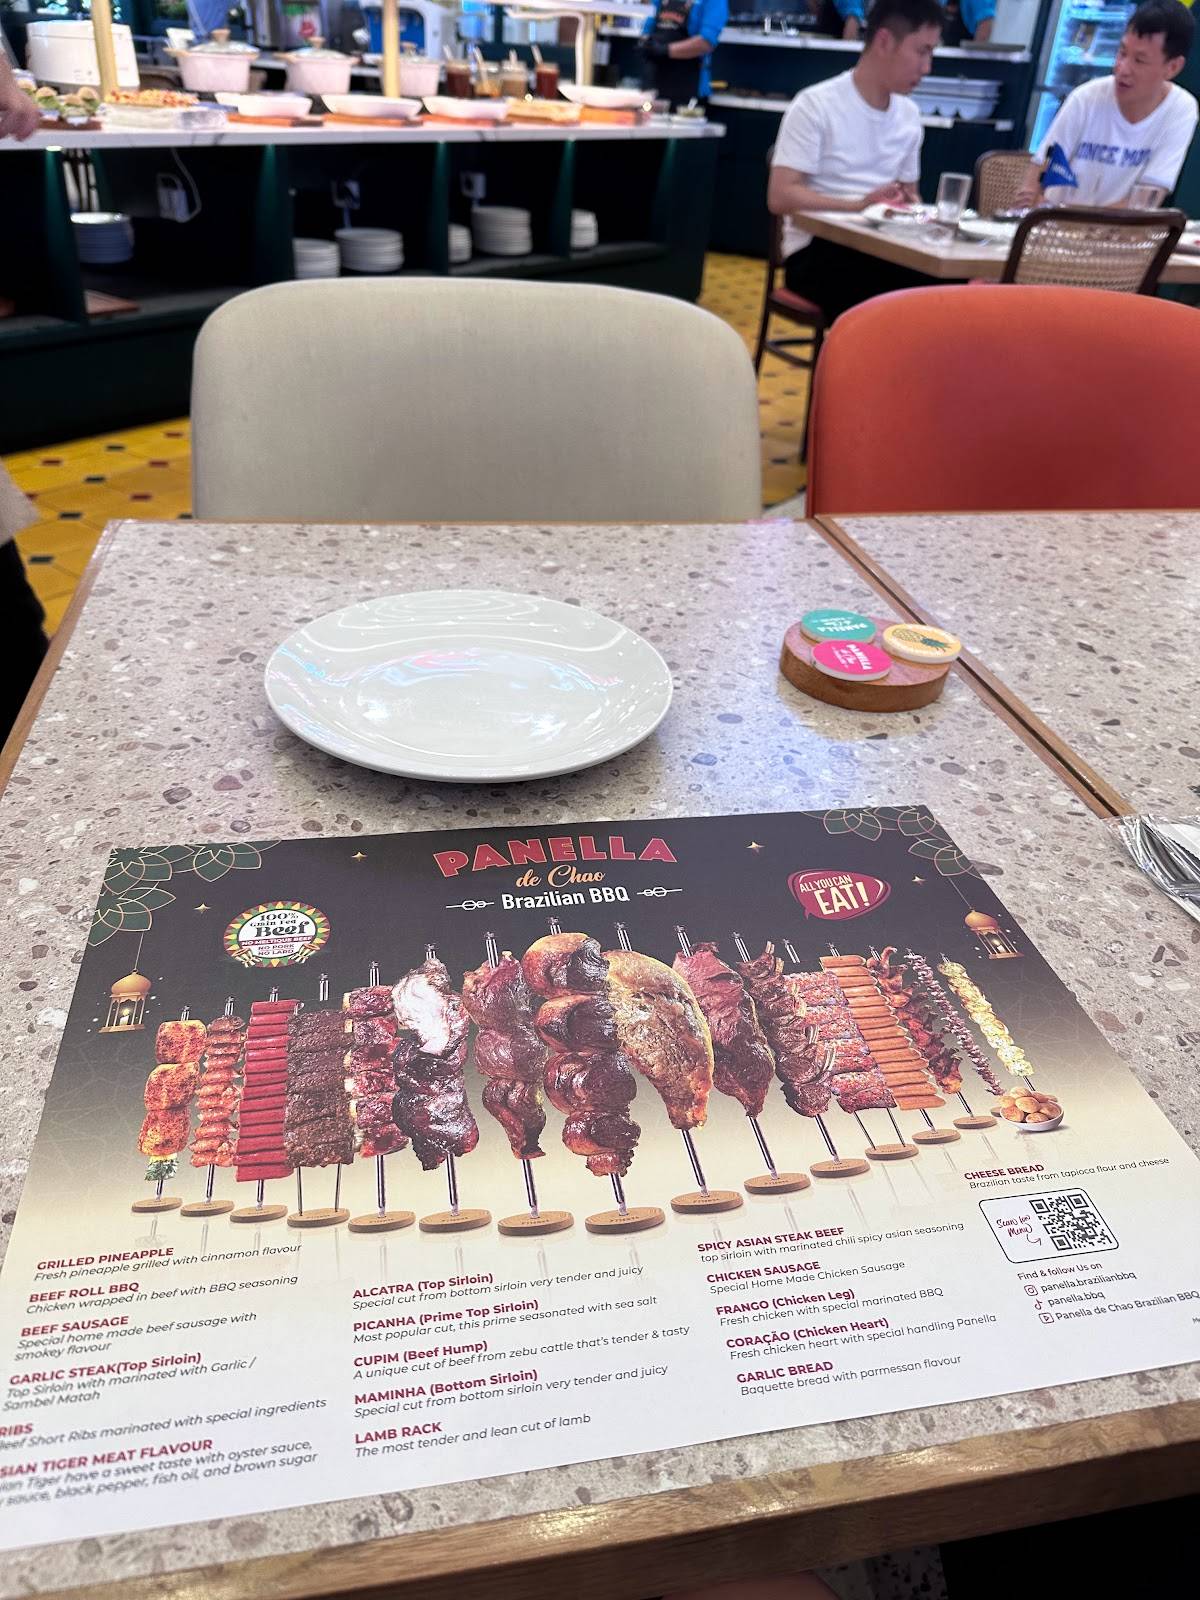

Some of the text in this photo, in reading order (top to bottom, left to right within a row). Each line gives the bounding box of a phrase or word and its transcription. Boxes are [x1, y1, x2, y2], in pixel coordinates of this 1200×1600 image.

[433, 836, 677, 878] PANELLA
[516, 865, 606, 888] de Chao
[800, 874, 853, 893] ALL YOU CAN
[501, 887, 630, 910] Brazilian BBQ
[814, 882, 870, 915] EAT!
[260, 912, 298, 921] 100%
[254, 937, 292, 945] MELTIQUE
[255, 921, 309, 937] Beef
[964, 1164, 1044, 1180] CHEESE BREAD
[969, 1178, 1010, 1189] Brazilian
[1060, 1168, 1095, 1178] tapioca
[1118, 1161, 1137, 1169] and
[1138, 1158, 1169, 1167] cheese
[995, 1218, 1018, 1229] Scan
[1008, 1223, 1032, 1237] Menu
[697, 1227, 844, 1252] SPICY ASIAN STEAK BEEF
[700, 1223, 964, 1263] top sirloin with marinated chili spicy asian seasoning
[37, 1247, 174, 1270] GRILLED PINEAPPLE
[706, 1261, 821, 1283] CHICKEN SAUSAGE
[1017, 1270, 1038, 1280] Find
[1047, 1267, 1075, 1275] follow
[1040, 1271, 1137, 1293] panella.brazilianbbq
[29, 1283, 140, 1303] BEEF ROLL BBQ
[353, 1275, 493, 1298] ALCATRA (Top Sirloin)
[353, 1267, 643, 1310] Special cut from bottom sirloin very tender and juicy
[716, 1289, 857, 1315] FRANGO (Chicken Leg)
[720, 1288, 944, 1326] Fresh chicken with special marinated BBQ
[1048, 1291, 1105, 1307] panella.bbq
[1055, 1308, 1092, 1321] Panella
[1094, 1306, 1107, 1315] de
[1108, 1302, 1134, 1312] Chao
[1134, 1296, 1177, 1308] Brazilian
[21, 1316, 129, 1337] BEEF SAUSAGE
[353, 1301, 538, 1332] PICANHA (Prime Top Sirloin)
[353, 1296, 657, 1343] Most popular cut, this prime seasonated with sea salt
[726, 1318, 889, 1348] CORAÇÃO (Chicken Heart)
[730, 1314, 997, 1360] Fresh chicken heart with special handling Panella
[354, 1342, 487, 1367] CUPIM (Beef Hump)
[9, 1370, 65, 1385] GARLIC
[151, 1354, 201, 1369] Sirloin)
[736, 1362, 833, 1383] GARLIC BREAD
[740, 1356, 960, 1396] Baquette bread with parmessan flavour
[354, 1372, 537, 1405] MAMINHA (Bottom Sirloin)
[354, 1366, 668, 1419] Special cut from bottom sirloin very tender and juicy
[355, 1423, 442, 1444] LAMB RACK
[356, 1415, 591, 1457] The most tender and lean cut of lamb
